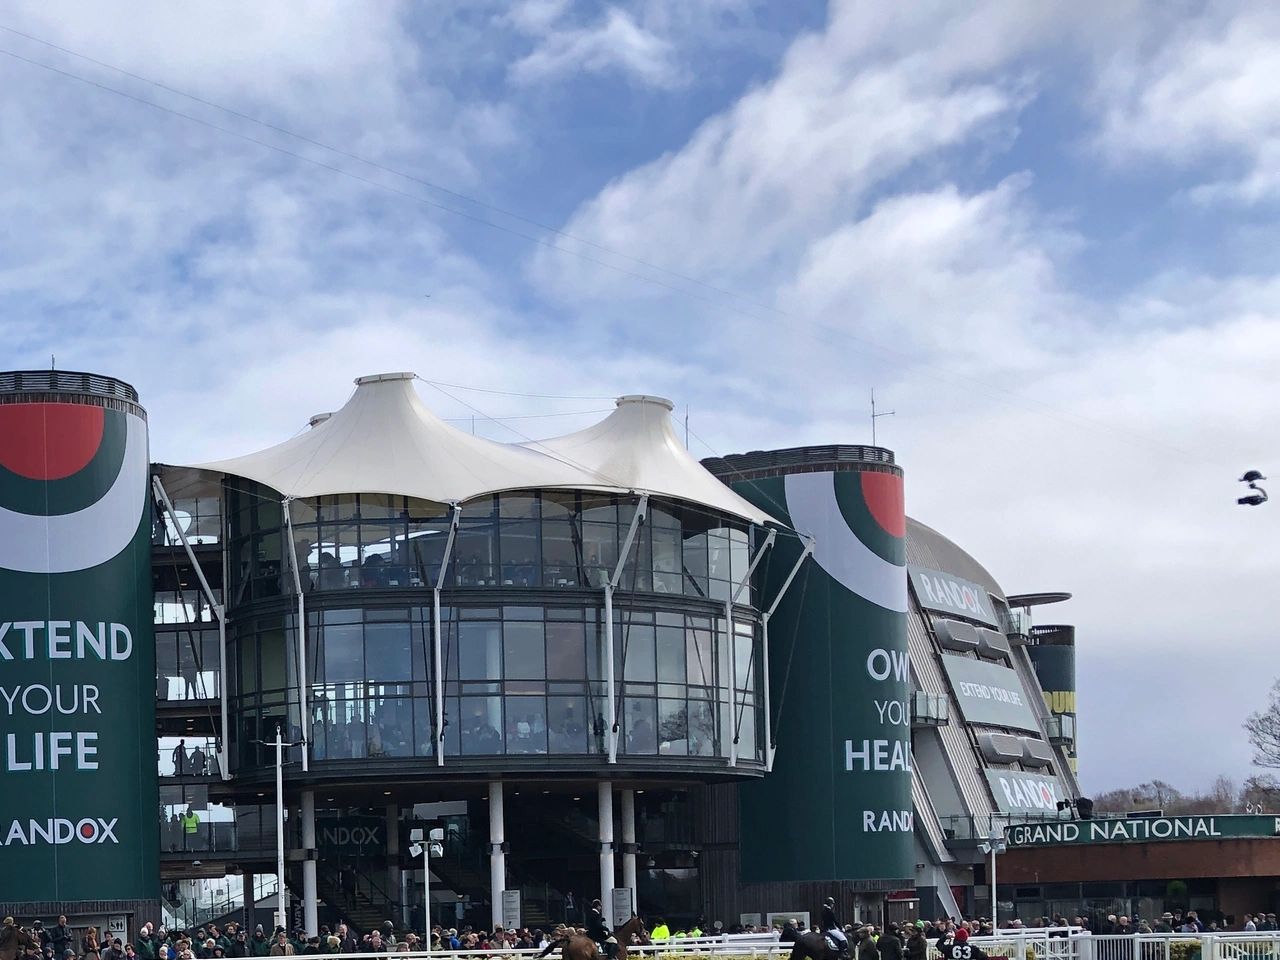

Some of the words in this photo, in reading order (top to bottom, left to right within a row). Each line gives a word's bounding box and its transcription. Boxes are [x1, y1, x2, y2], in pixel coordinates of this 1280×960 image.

[919, 573, 987, 617] RANDOX
[0, 683, 103, 716] YOUR
[959, 681, 992, 700] EXTEND
[874, 700, 910, 726] YOU
[6, 731, 100, 772] LIFE
[845, 739, 912, 771] HEAL
[999, 777, 1058, 810] RANDOX
[863, 810, 914, 832] RAND
[1014, 823, 1079, 845] GRAND
[1090, 817, 1221, 841] NATIONAL
[320, 825, 381, 846] NDOX
[951, 945, 972, 959] 63
